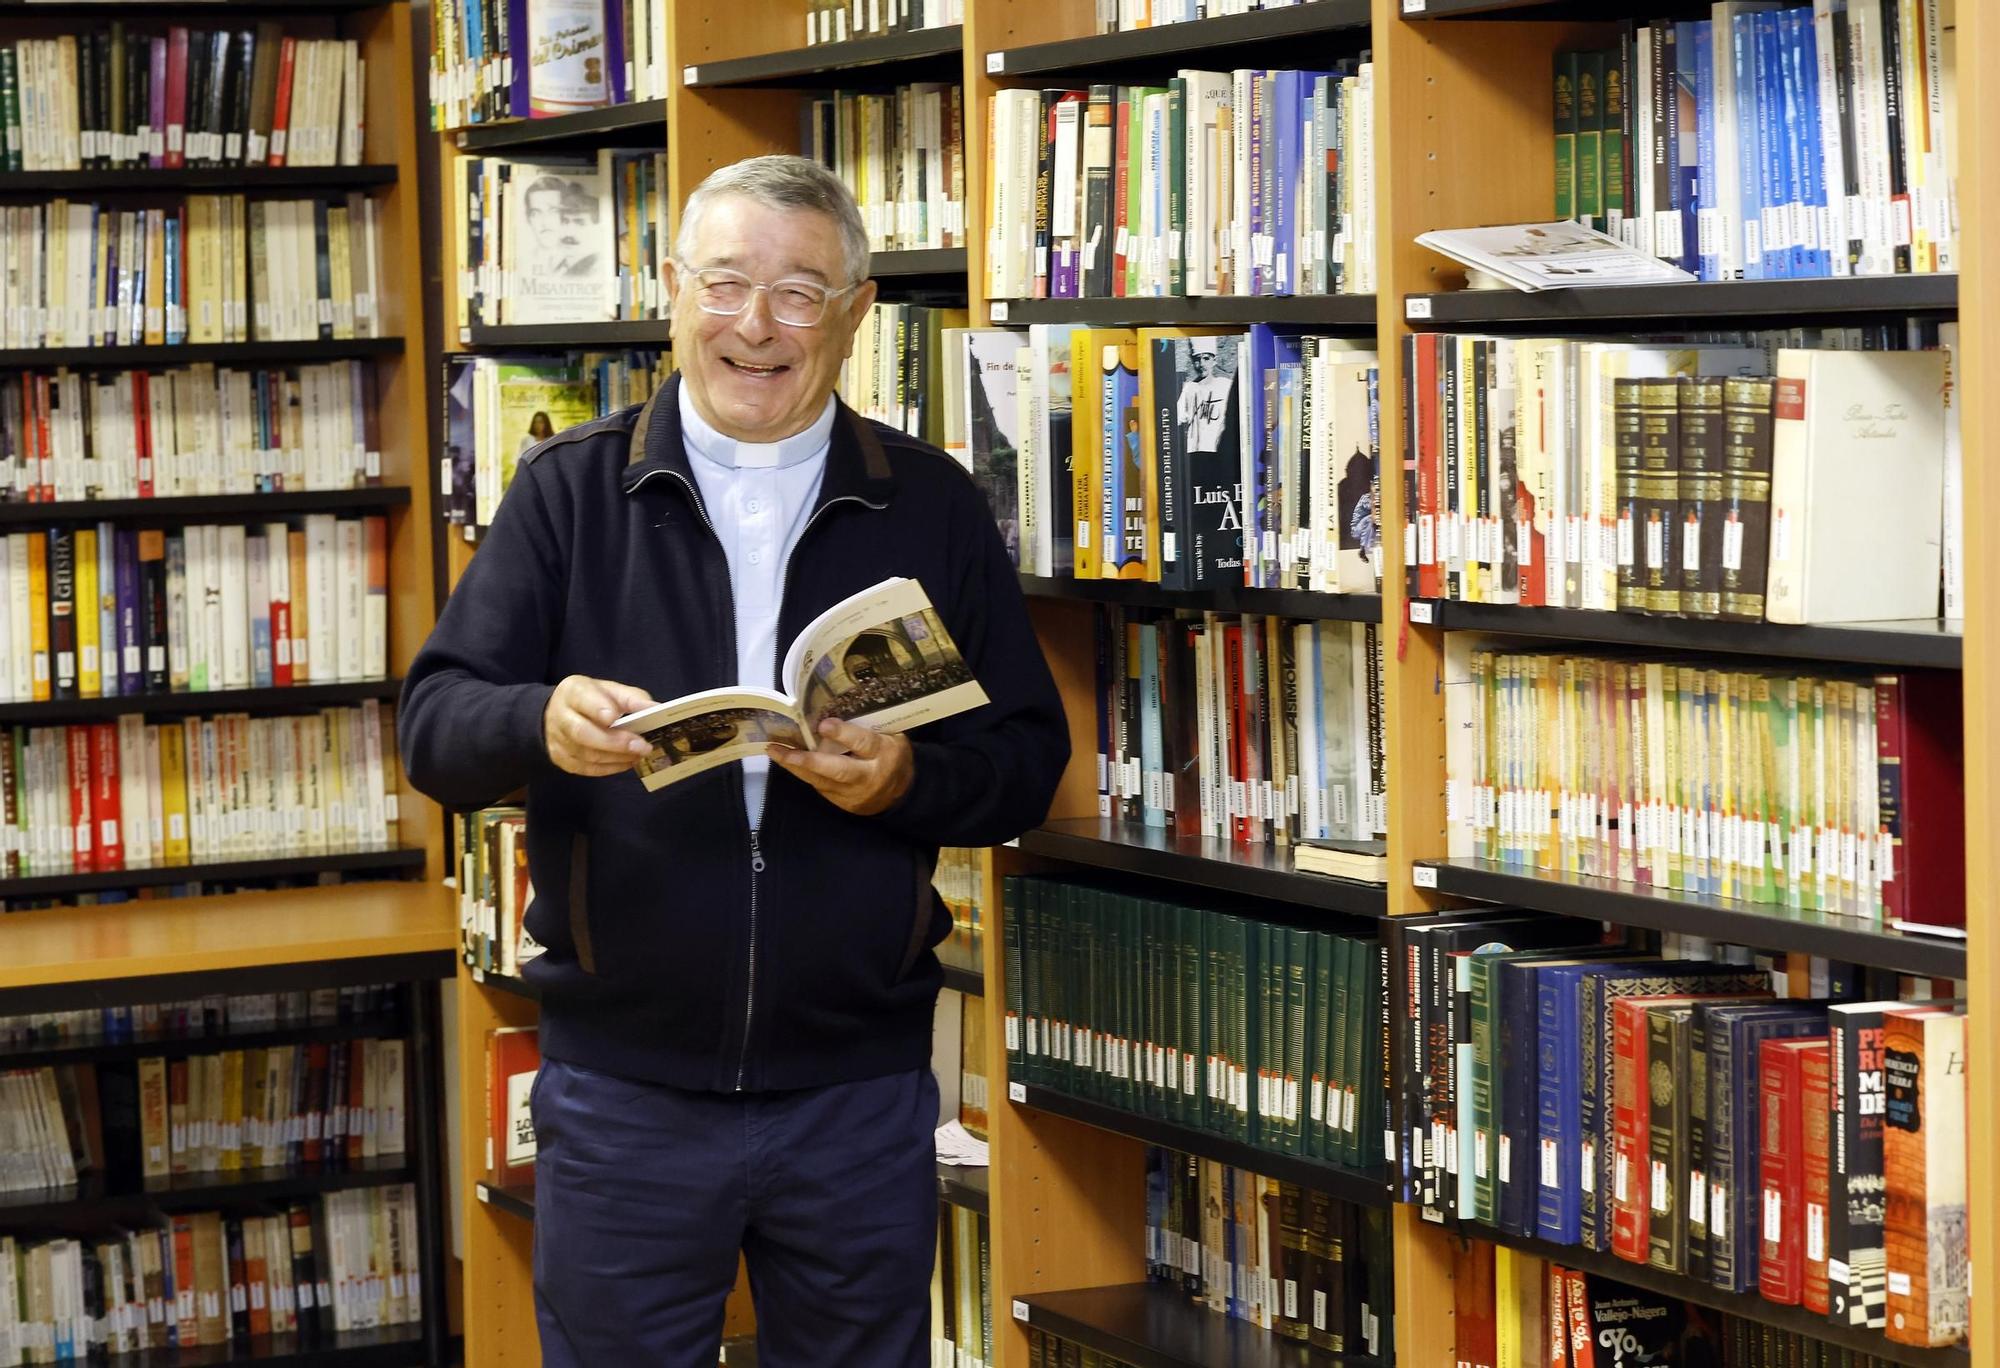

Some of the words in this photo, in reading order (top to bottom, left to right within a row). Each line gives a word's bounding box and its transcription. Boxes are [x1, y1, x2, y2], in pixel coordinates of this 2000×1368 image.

[1654, 28, 1663, 63] sosiego
[1929, 35, 1936, 45] tu
[1929, 49, 1938, 61] de
[1252, 76, 1260, 121] CORDEROS
[1655, 84, 1663, 122] Tumbas
[1252, 125, 1260, 140] LOS
[1252, 143, 1260, 153] DE
[1656, 136, 1665, 164] Rojas
[1252, 156, 1260, 194] SILENCIO
[1264, 169, 1272, 206] SPARKS
[1252, 197, 1260, 206] EL
[1446, 370, 1454, 400] PRAGA
[1103, 380, 1113, 424] TEATRO
[1447, 406, 1454, 417] EN
[1103, 430, 1113, 445] DE
[1161, 408, 1171, 449] DELITO
[1303, 399, 1312, 449] ERASMO
[1447, 422, 1455, 465] MUJERES
[1103, 449, 1113, 483] LIBRO
[1163, 451, 1172, 473] DEL
[1447, 470, 1455, 489] DOS
[1164, 476, 1173, 521] CUERPO
[1193, 485, 1230, 504] Luis
[1103, 489, 1113, 532] PRIMER
[1328, 515, 1334, 531] LA
[56, 536, 71, 598] GEISHA
[1216, 557, 1241, 569] Todas
[1367, 629, 1376, 703] ultramodernidad
[1284, 656, 1298, 730] ASIMOV
[1381, 946, 1389, 987] NOCHE
[1382, 991, 1389, 1005] LA
[1382, 1009, 1389, 1024] DE
[1414, 1007, 1421, 1018] AL
[1837, 1028, 1845, 1095] DESCUBIERTO
[1384, 1075, 1391, 1088] EL
[1837, 1098, 1845, 1112] AL
[1837, 1114, 1845, 1174] MASONERÍA
[1570, 1278, 1586, 1304] rey
[1570, 1307, 1584, 1321] el
[1594, 1306, 1667, 1323] Vallejo-Nágera
[1570, 1322, 1590, 1350] Yo,
[1599, 1327, 1643, 1358] Yo,
